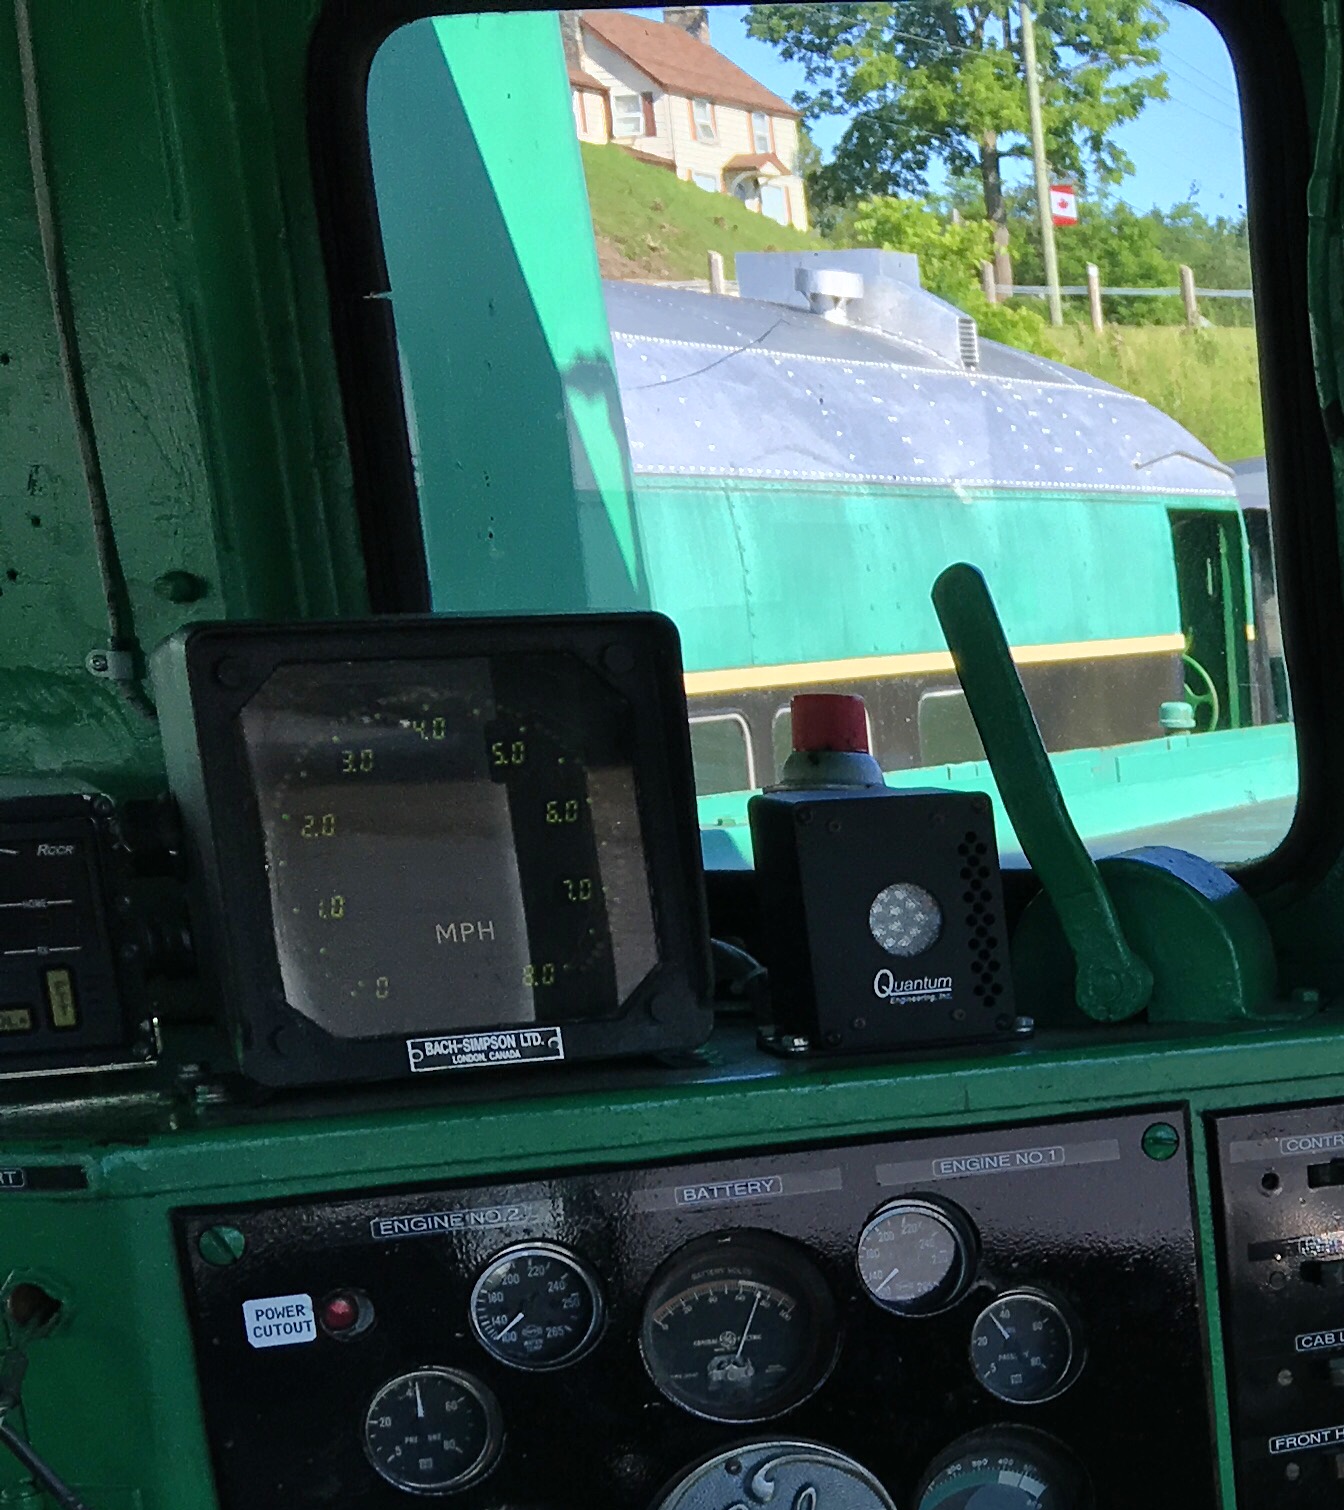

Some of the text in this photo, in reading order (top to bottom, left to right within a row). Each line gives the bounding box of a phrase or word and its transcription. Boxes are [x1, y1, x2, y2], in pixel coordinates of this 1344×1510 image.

[436, 920, 496, 944] MPH
[874, 968, 952, 998] Quantum
[425, 1032, 545, 1056] BACH-SIMPSON LTD.
[488, 1049, 521, 1060] CANADA
[940, 1154, 1011, 1173] ENGINE
[683, 1179, 775, 1200] BATTERY
[380, 1214, 465, 1235] ENGINE
[502, 1274, 520, 1285] 200
[527, 1265, 545, 1278] 220
[547, 1280, 566, 1293] 240
[255, 1304, 305, 1321] POWER
[253, 1320, 312, 1338] CUTOUT
[1301, 1334, 1335, 1348] CAB
[380, 1416, 392, 1428] 20
[1275, 1431, 1331, 1450] FRONT
